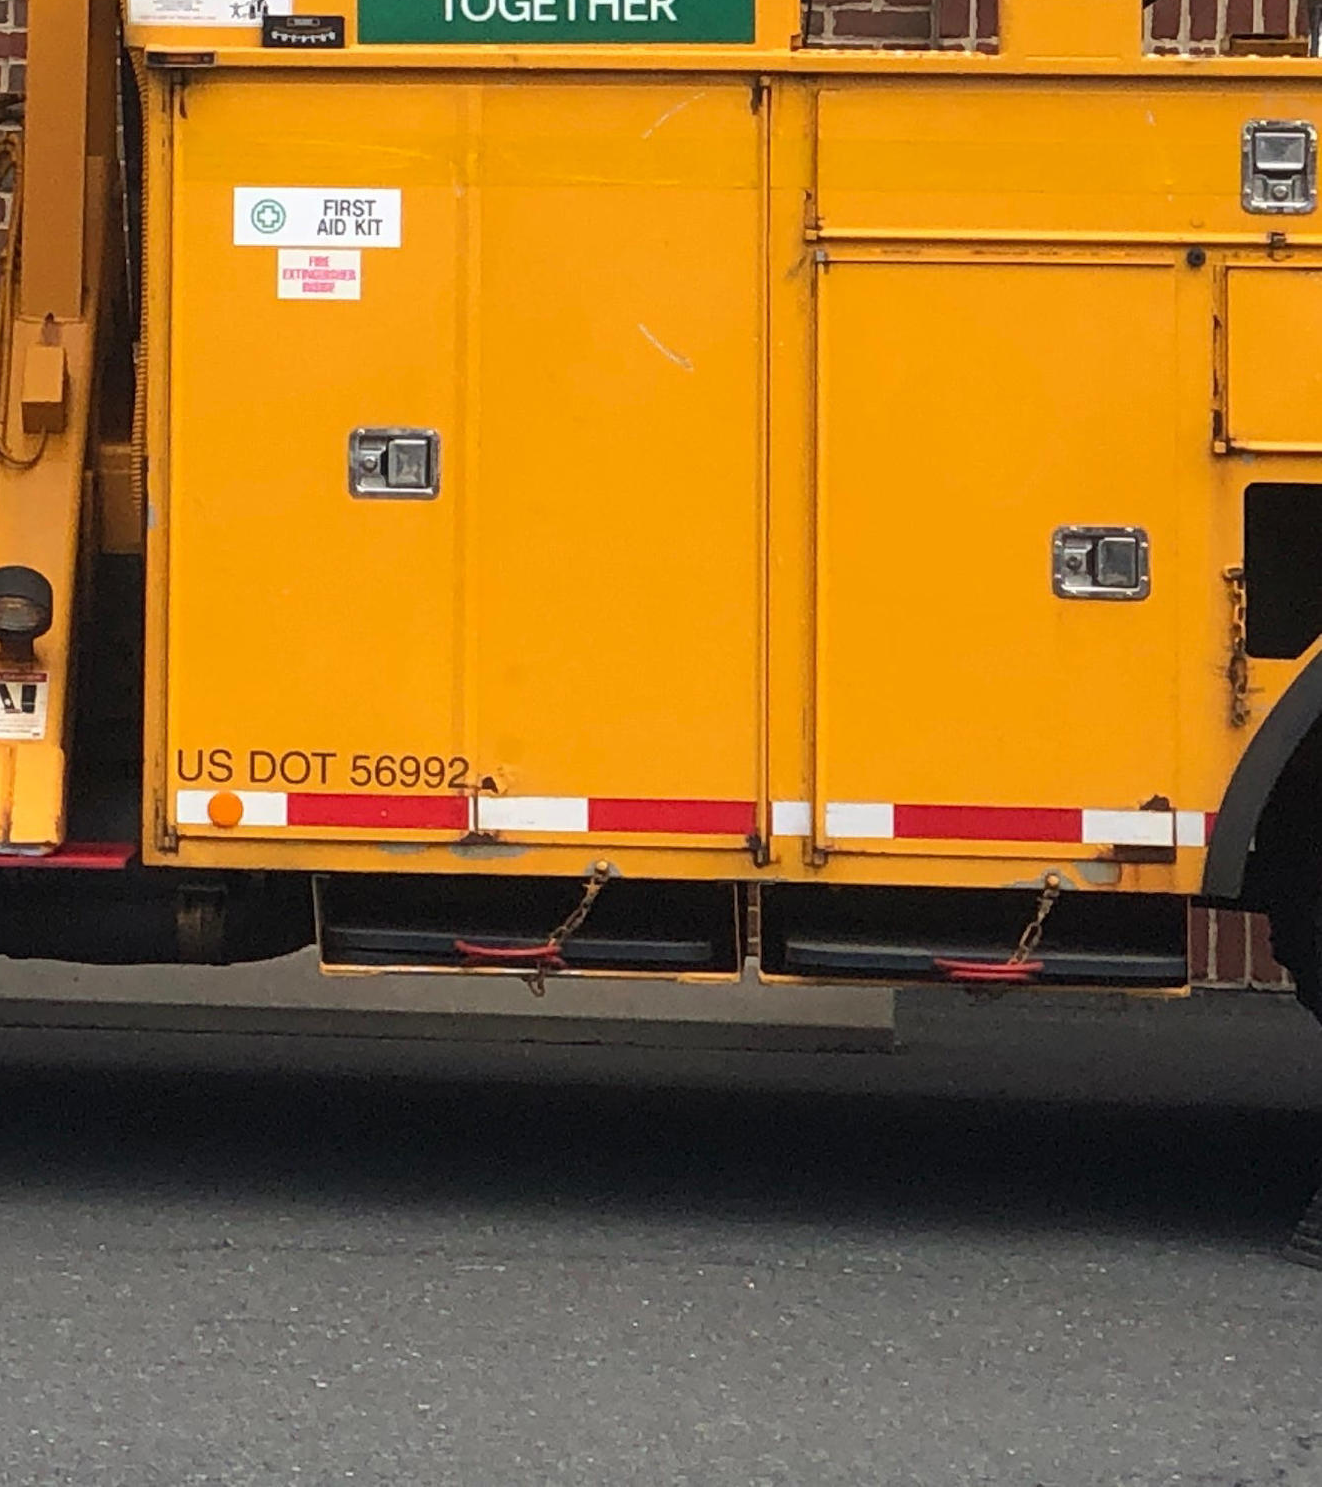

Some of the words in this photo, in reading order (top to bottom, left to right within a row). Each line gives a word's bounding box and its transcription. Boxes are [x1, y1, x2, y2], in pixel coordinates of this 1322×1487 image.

[323, 199, 376, 217] FIRST
[317, 218, 347, 236] AID
[355, 218, 383, 236] KIT
[178, 749, 233, 783] US
[249, 750, 337, 784] DOT
[349, 754, 470, 789] 56992
